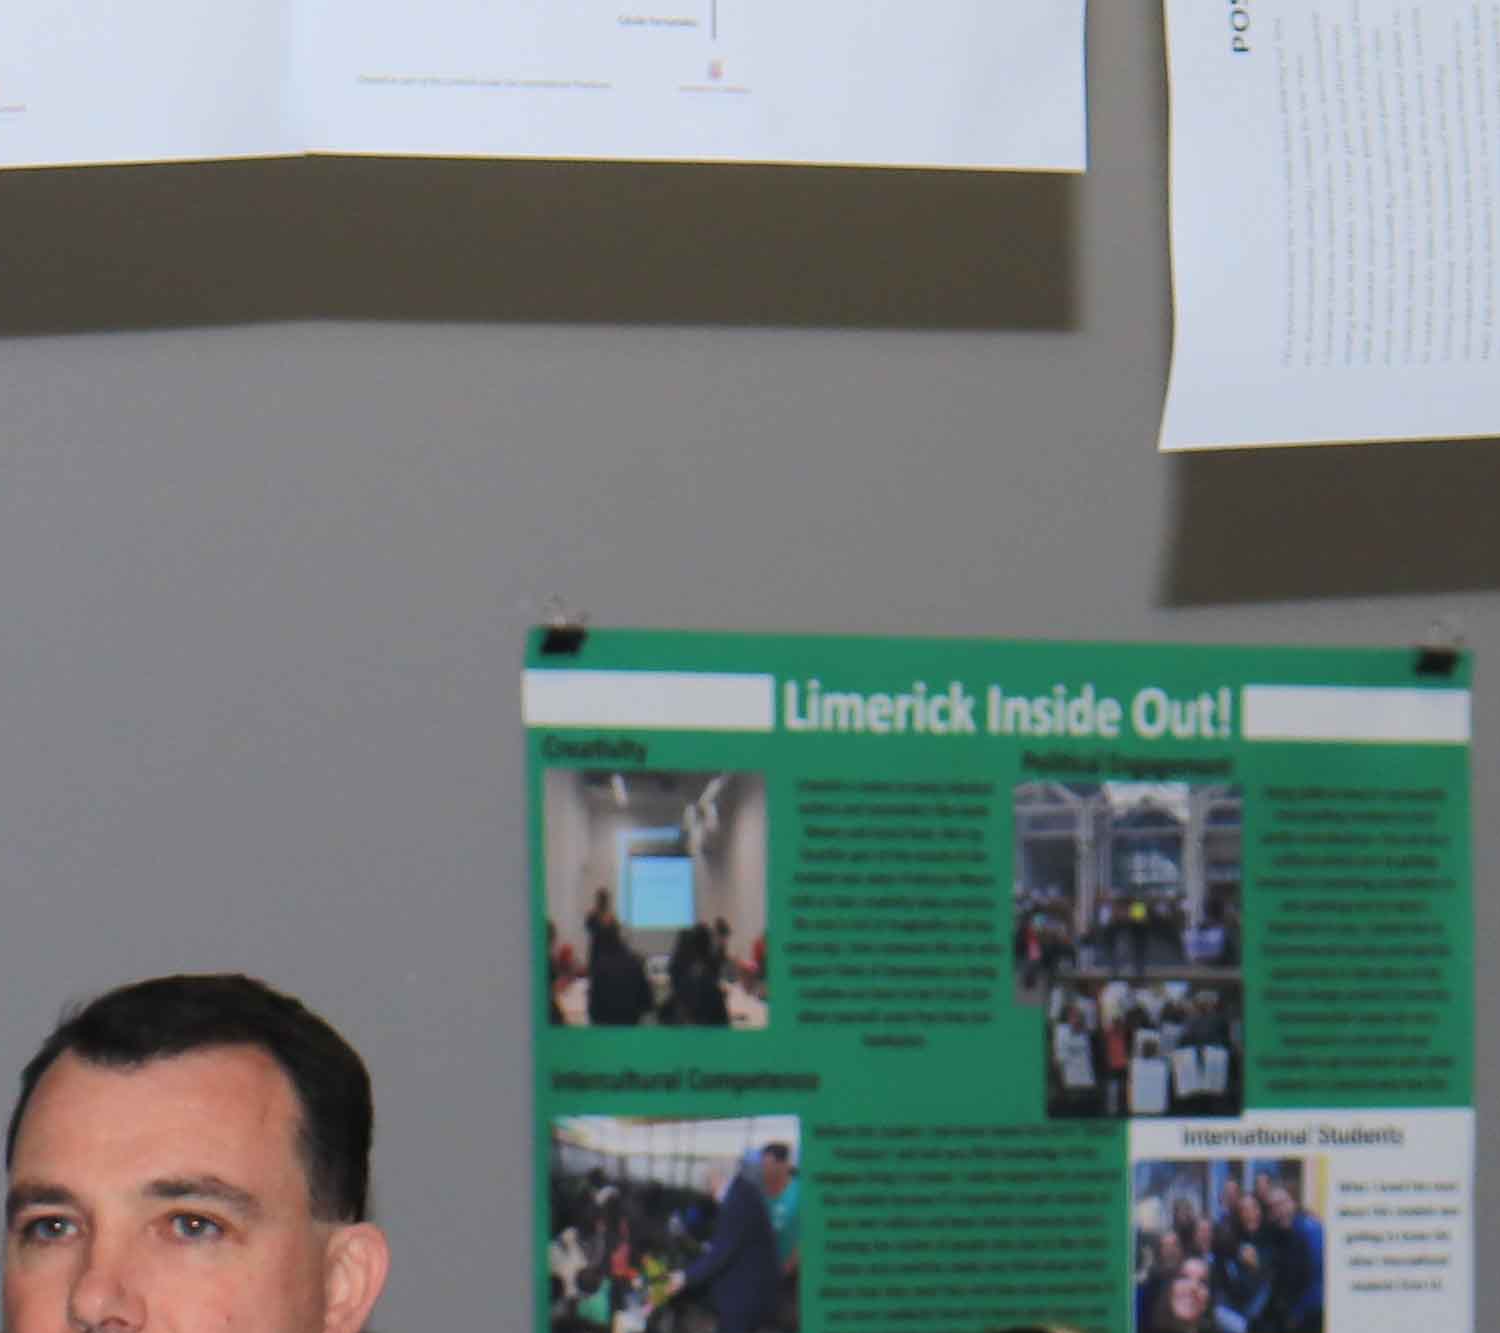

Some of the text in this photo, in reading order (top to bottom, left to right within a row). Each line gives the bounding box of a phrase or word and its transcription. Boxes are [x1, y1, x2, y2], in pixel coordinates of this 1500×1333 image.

[785, 678, 1232, 741] Limerick Inside Out!
[542, 738, 646, 762] Creativity
[1022, 752, 1100, 773] Political
[552, 1069, 819, 1096] Intercultural Competence
[1183, 1126, 1308, 1149] International
